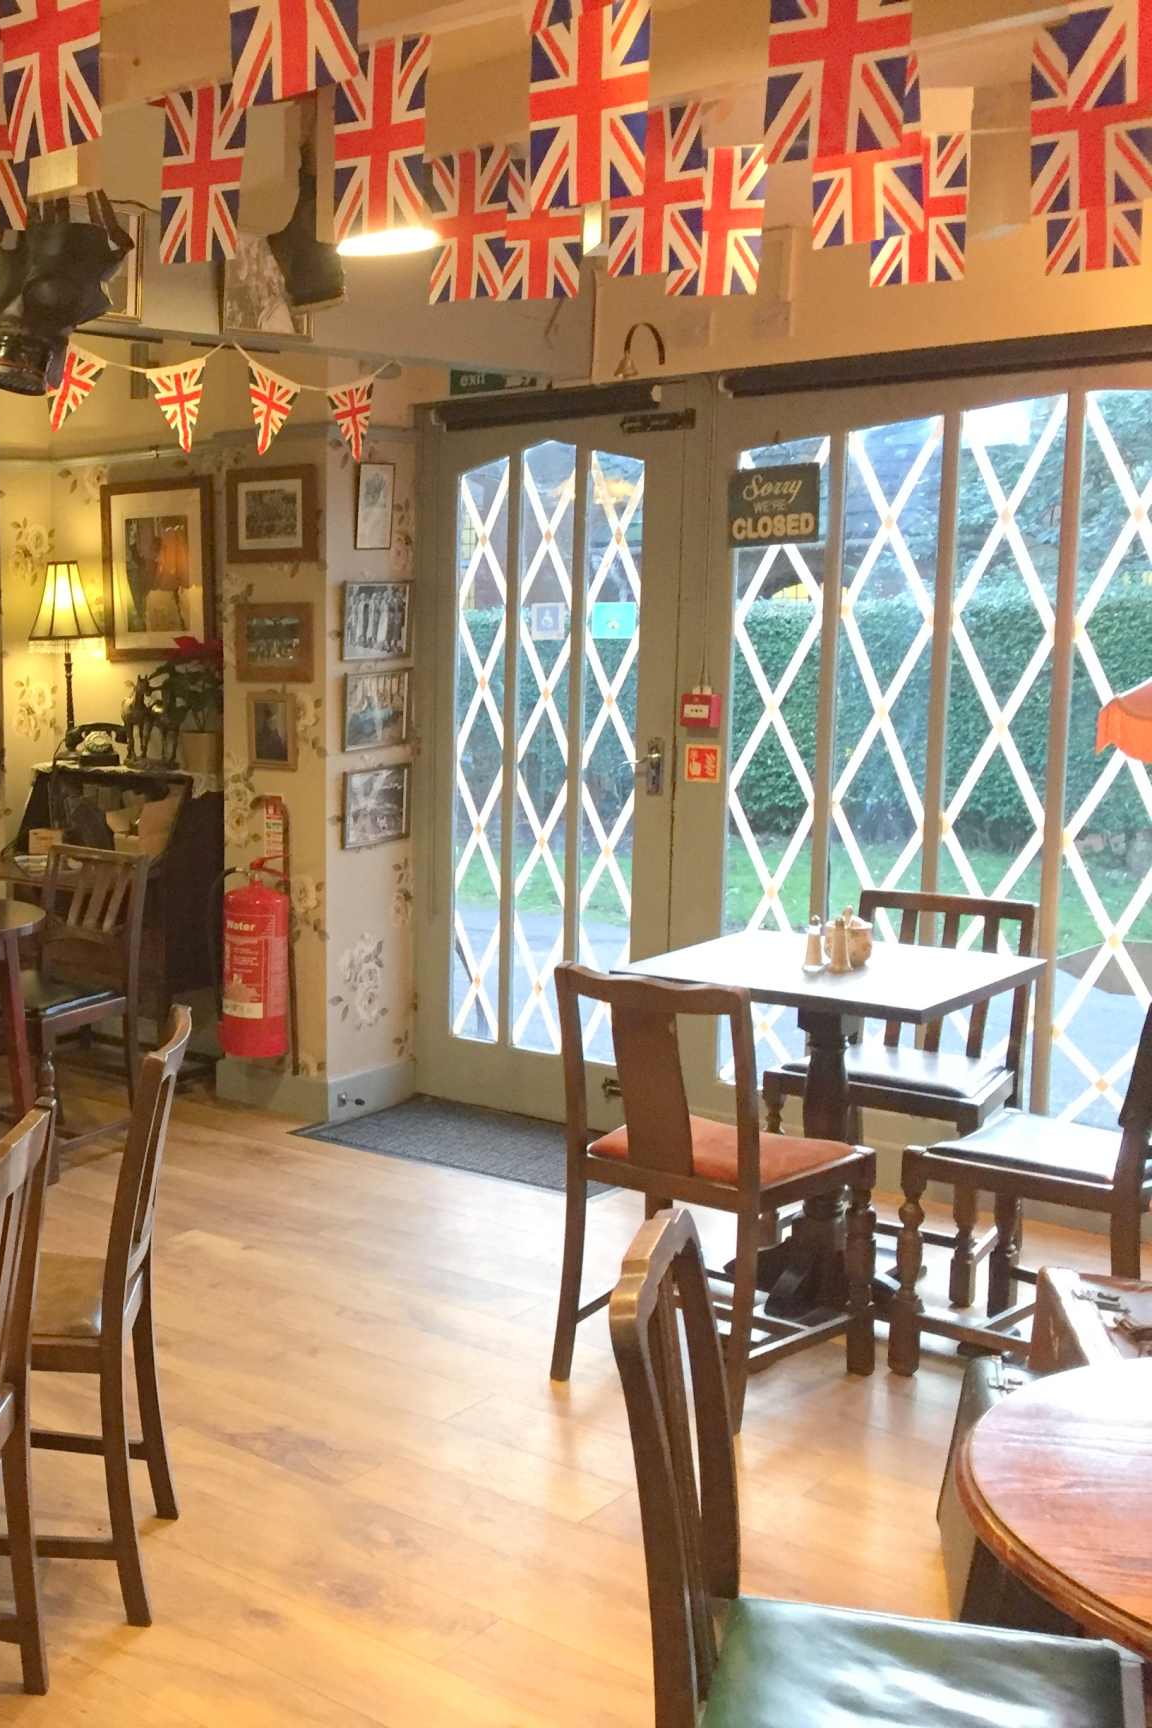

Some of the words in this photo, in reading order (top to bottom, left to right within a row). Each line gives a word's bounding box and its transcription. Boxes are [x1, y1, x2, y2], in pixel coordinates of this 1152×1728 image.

[460, 371, 486, 387] exit
[742, 474, 803, 505] Sorry
[753, 499, 788, 514] WE'RE
[732, 512, 815, 540] CLOSED
[226, 918, 256, 932] Water
